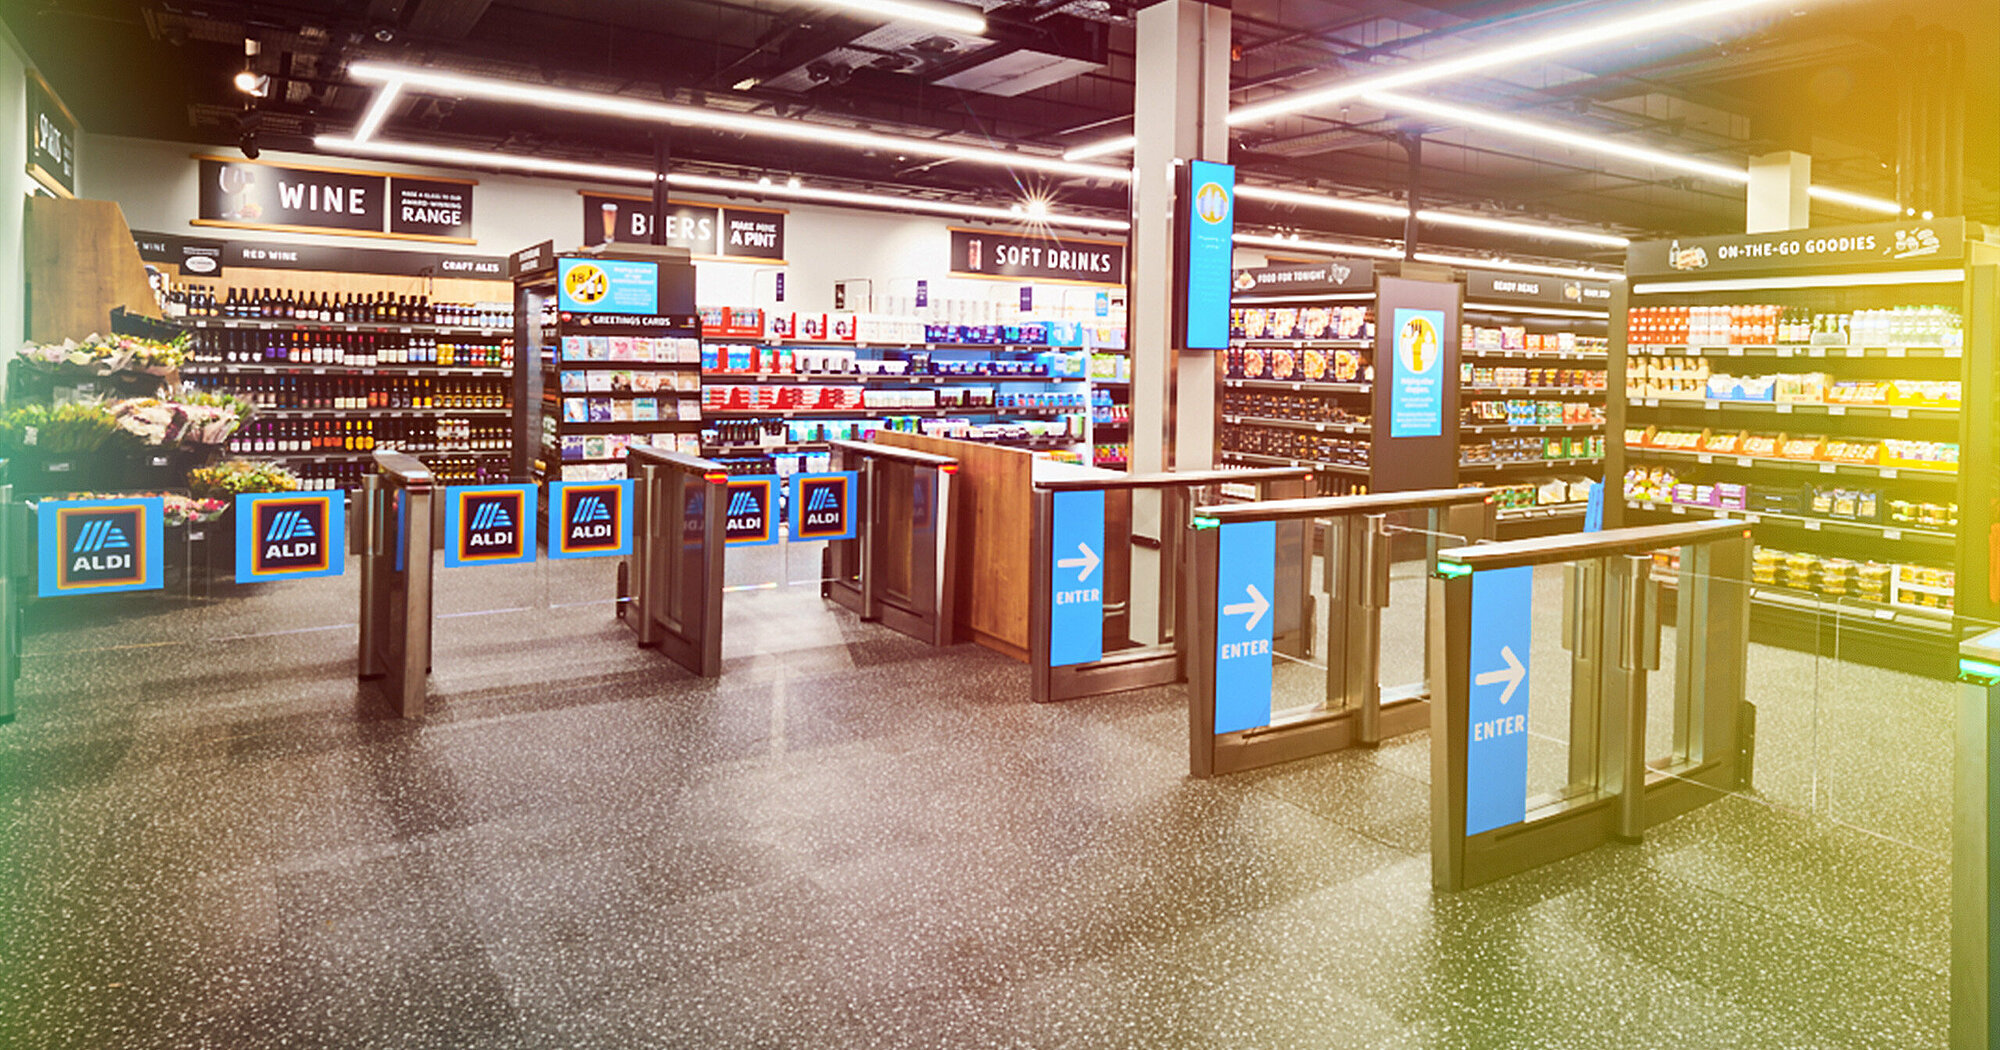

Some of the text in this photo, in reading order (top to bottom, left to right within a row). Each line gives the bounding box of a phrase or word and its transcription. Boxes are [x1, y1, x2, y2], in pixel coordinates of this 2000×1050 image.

[279, 182, 366, 214] WINE
[402, 206, 462, 225] RANGE
[730, 230, 777, 248] A PINT
[1718, 235, 1876, 259] ON-THE-GO GOODIES
[142, 243, 166, 252] WINE
[243, 249, 298, 261] RED WINE
[996, 244, 1111, 272] SOFT DRINKS
[442, 261, 500, 273] CRAFT ALES
[1294, 270, 1325, 281] TONIGHT
[592, 315, 671, 327] GREETINGS CARDS
[727, 518, 761, 530] ALDI
[806, 512, 839, 525] ALDI
[470, 532, 513, 546] ALDI
[571, 524, 611, 538] ALDI
[265, 543, 317, 559] ALDI
[73, 554, 131, 572] ALDI
[1056, 588, 1100, 605] ENTER
[1221, 639, 1269, 660] ENTER
[1474, 714, 1525, 742] ENTER
